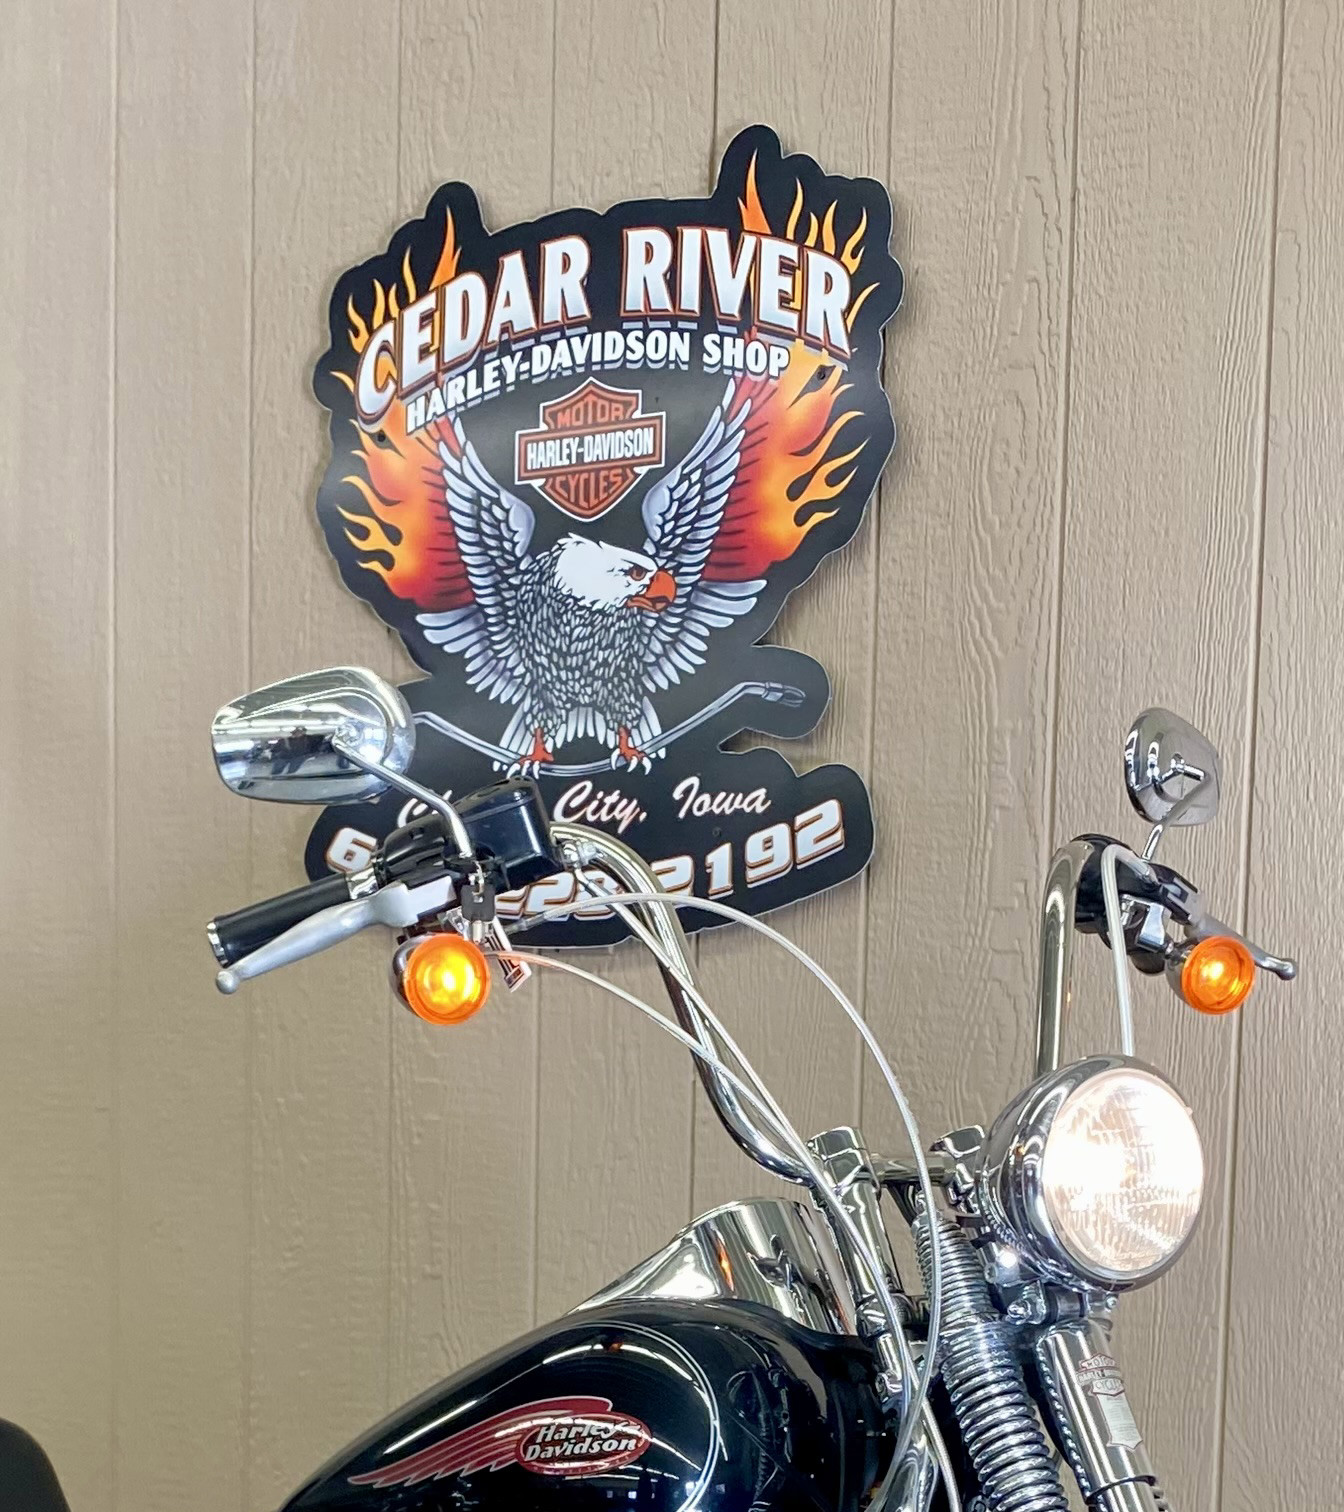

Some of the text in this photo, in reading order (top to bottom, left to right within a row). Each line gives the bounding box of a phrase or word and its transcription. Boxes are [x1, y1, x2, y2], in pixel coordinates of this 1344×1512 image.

[356, 226, 852, 420] CEDAR RIVER
[406, 330, 790, 433] HARLEY-DAVIDSON SHOP
[557, 394, 624, 429] MOTOR
[527, 427, 654, 470] HARLEY-DAVIDSON
[555, 467, 623, 509] CYCLES
[673, 776, 771, 820] Iowa
[524, 1437, 637, 1461] Davidson
